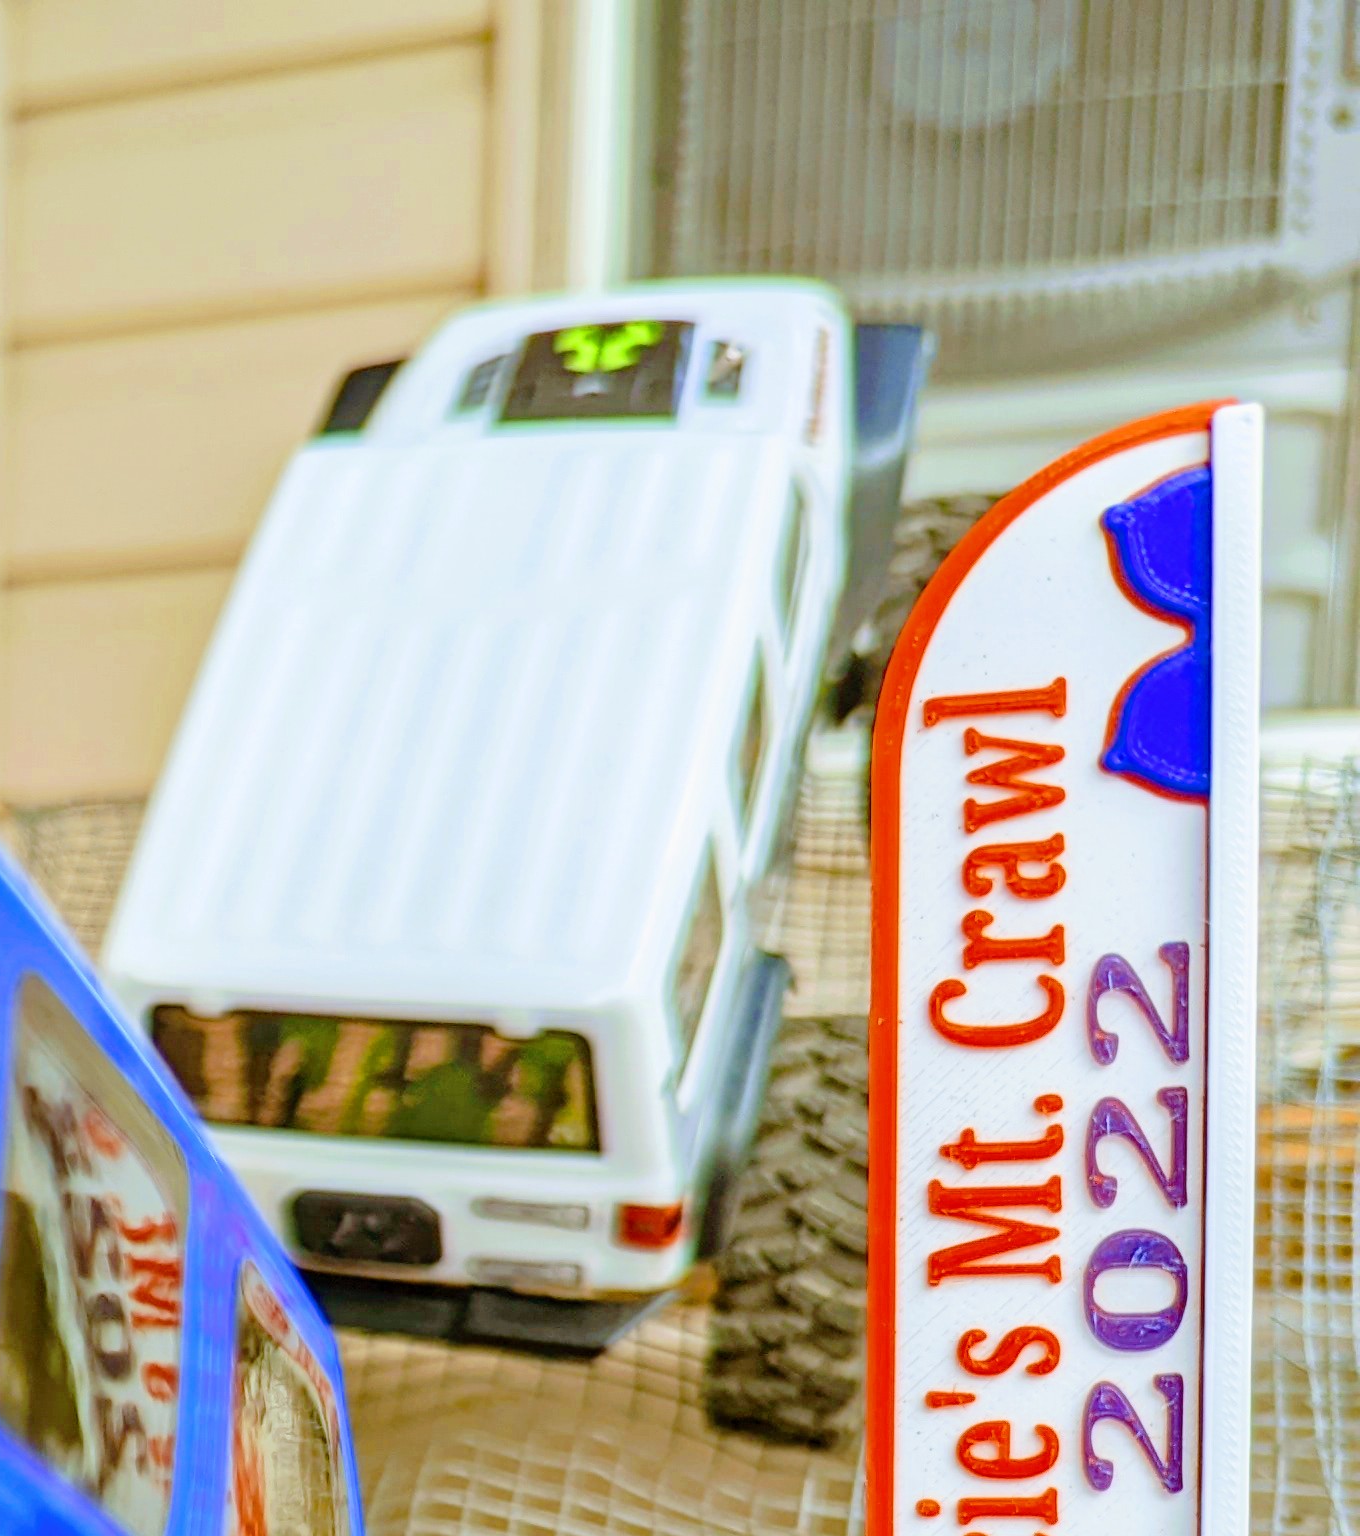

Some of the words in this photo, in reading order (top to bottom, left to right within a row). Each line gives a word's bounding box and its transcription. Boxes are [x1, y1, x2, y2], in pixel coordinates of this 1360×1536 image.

[920, 675, 1069, 1052] Crawl
[925, 1092, 1067, 1290] Mt.
[1084, 939, 1191, 1496] 2022
